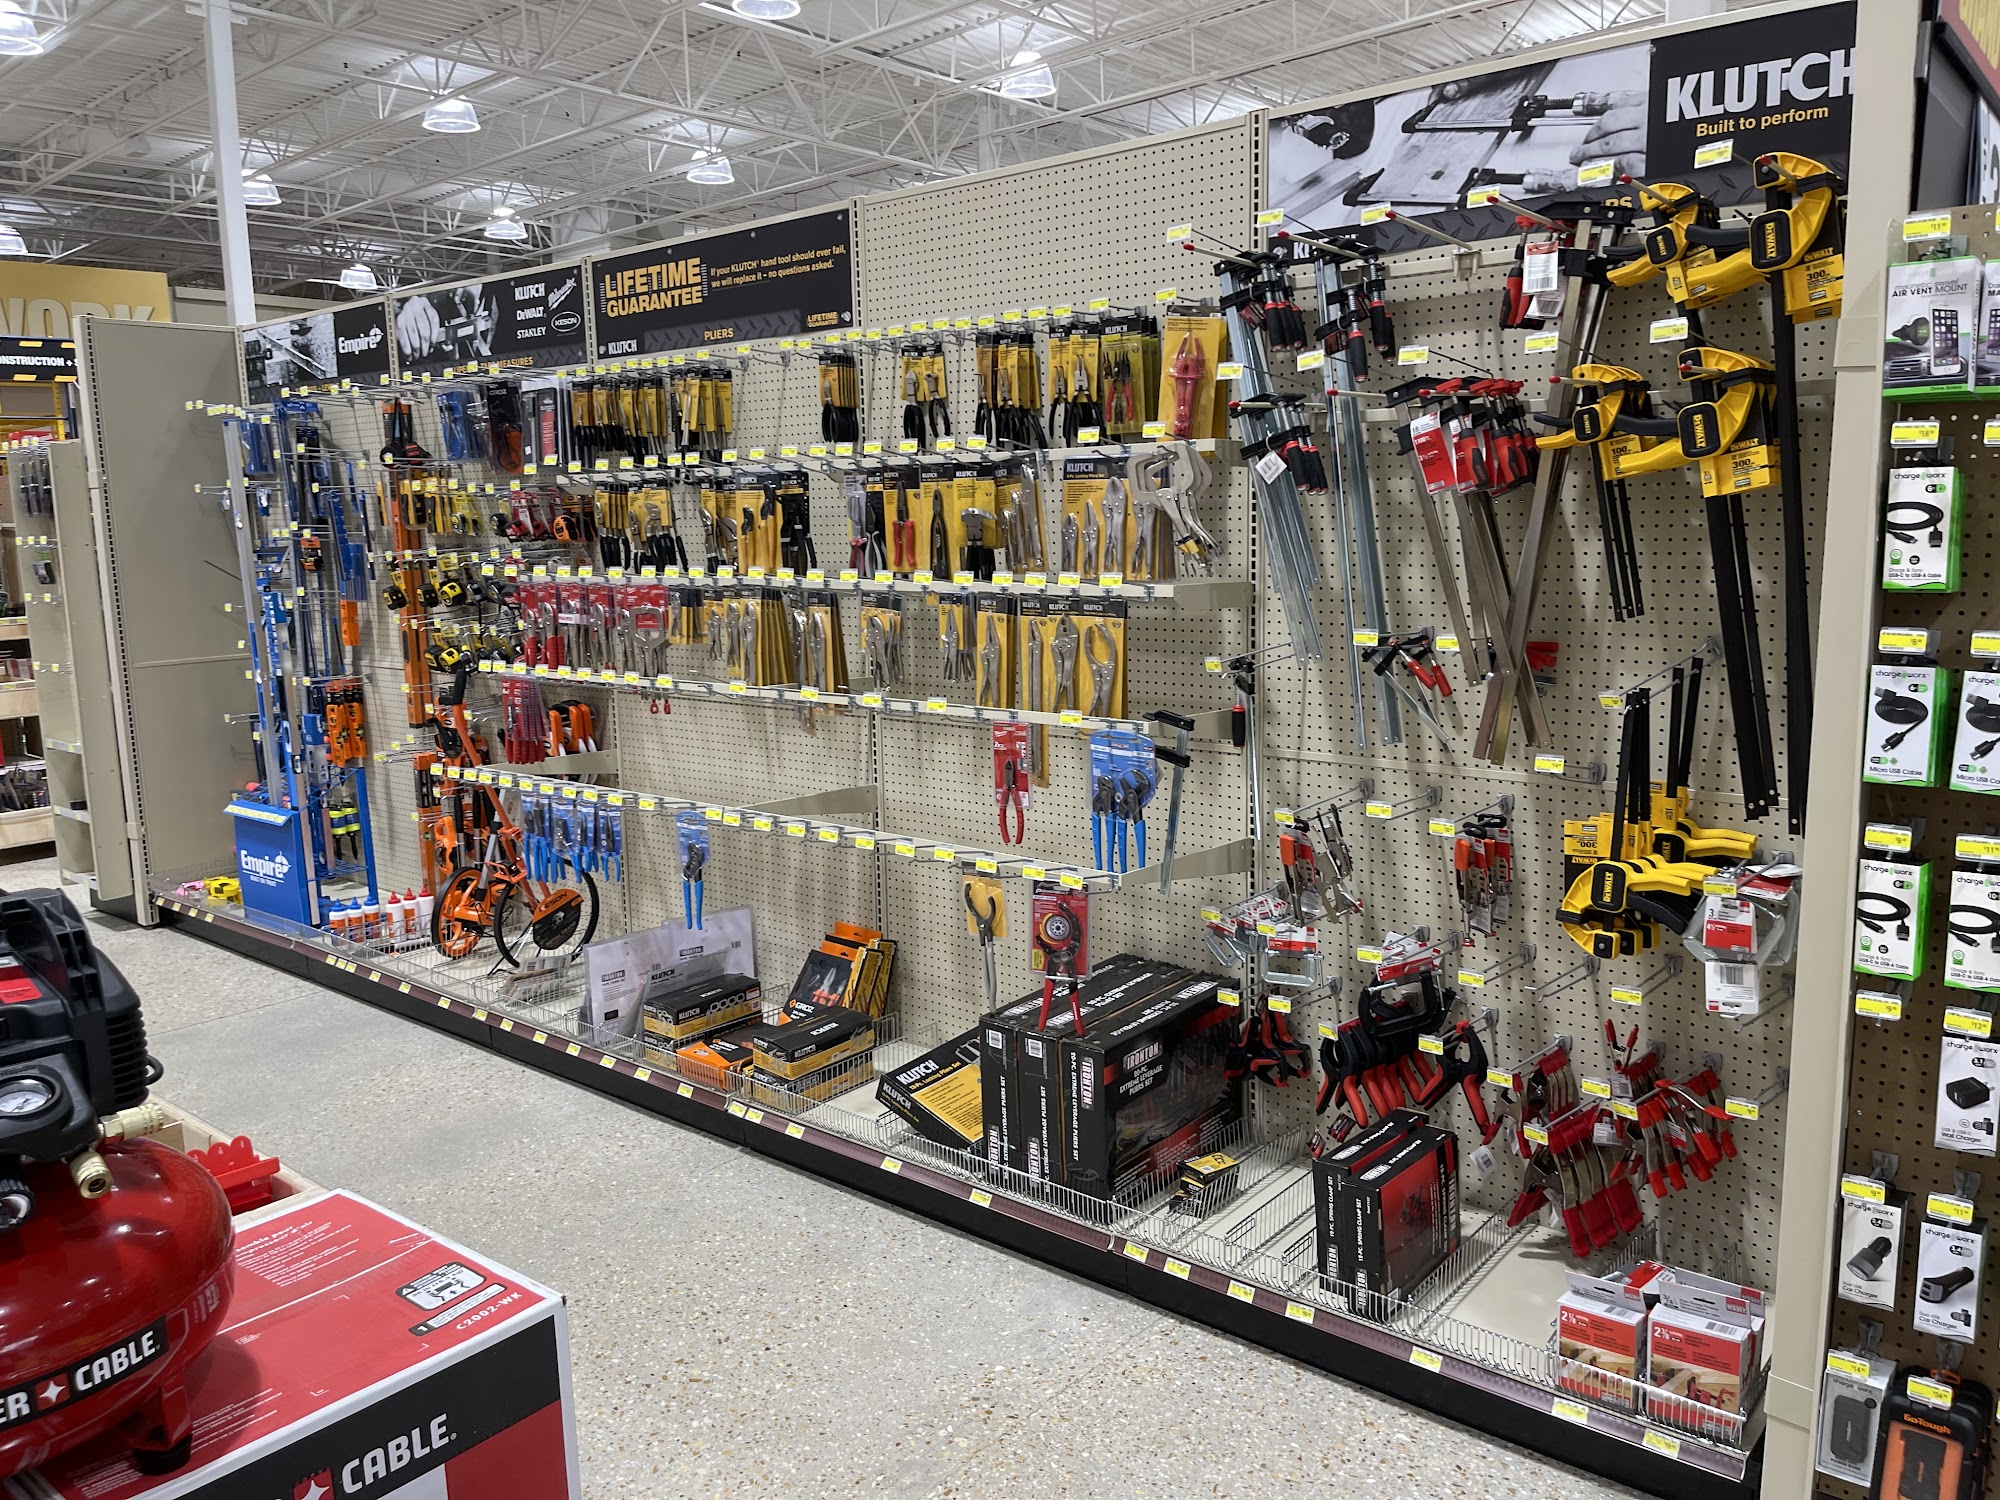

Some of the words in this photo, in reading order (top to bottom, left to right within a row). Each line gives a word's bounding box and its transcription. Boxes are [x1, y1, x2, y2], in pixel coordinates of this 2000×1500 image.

[1665, 47, 1856, 123] KLUTCH
[1696, 118, 1734, 137] Built
[1739, 117, 1756, 130] to
[1760, 106, 1829, 129] perform
[710, 267, 716, 276] If
[716, 266, 731, 277] your
[760, 257, 777, 267] hand
[778, 254, 791, 264] tool
[792, 250, 815, 262] should
[816, 249, 831, 258] ever
[605, 257, 702, 299] LIFETIME
[711, 280, 721, 288] we
[721, 276, 733, 287] will
[733, 274, 756, 285] replace
[778, 264, 810, 279] questions
[1806, 269, 1826, 281] 300
[515, 283, 546, 301] KLUTCH
[1910, 287, 1932, 296] VENT
[1934, 284, 1968, 293] MOUNT
[606, 285, 703, 318] GUARANTEE
[554, 317, 578, 327] KESON
[807, 312, 838, 322] LIFETIME
[517, 326, 547, 339] STANLEY
[704, 328, 734, 341] PLIERS
[1105, 325, 1128, 335] KLUTCH
[338, 333, 378, 354] Empire
[608, 339, 638, 355] KLUTCH
[1611, 445, 1628, 455] 100
[1067, 462, 1094, 473] KLUTCH
[1732, 459, 1751, 469] 300
[1049, 603, 1070, 611] KLUTCH
[1902, 768, 1923, 776] Cable
[1976, 775, 1989, 783] USB
[241, 850, 284, 879] Empire
[651, 968, 676, 981] KLUTCH
[679, 1008, 700, 1020] KLUTCH
[795, 1001, 815, 1014] GROZ
[794, 1044, 816, 1058] KLUTCH
[1127, 1041, 1159, 1071] IRONTON
[896, 1060, 940, 1085] KLUTCH
[1119, 1075, 1140, 1094] EXTREME
[1139, 1065, 1163, 1084] LEVERAGE
[1081, 1061, 1093, 1106] IRONTON
[1129, 1082, 1144, 1096] PLIERS
[1144, 1077, 1153, 1088] SET
[882, 1083, 912, 1110] KLUTCH
[1001, 1107, 1009, 1136] LEVERAGE
[1955, 1134, 1982, 1143] Charger
[1328, 1247, 1338, 1278] RONTON
[1854, 1288, 1879, 1299] Charger
[456, 1291, 523, 1331] C2002-WK
[1931, 1318, 1957, 1330] Charger
[75, 1330, 156, 1391] CABLE
[1903, 1413, 1952, 1434] GoTough
[342, 1413, 450, 1494] CABLE
